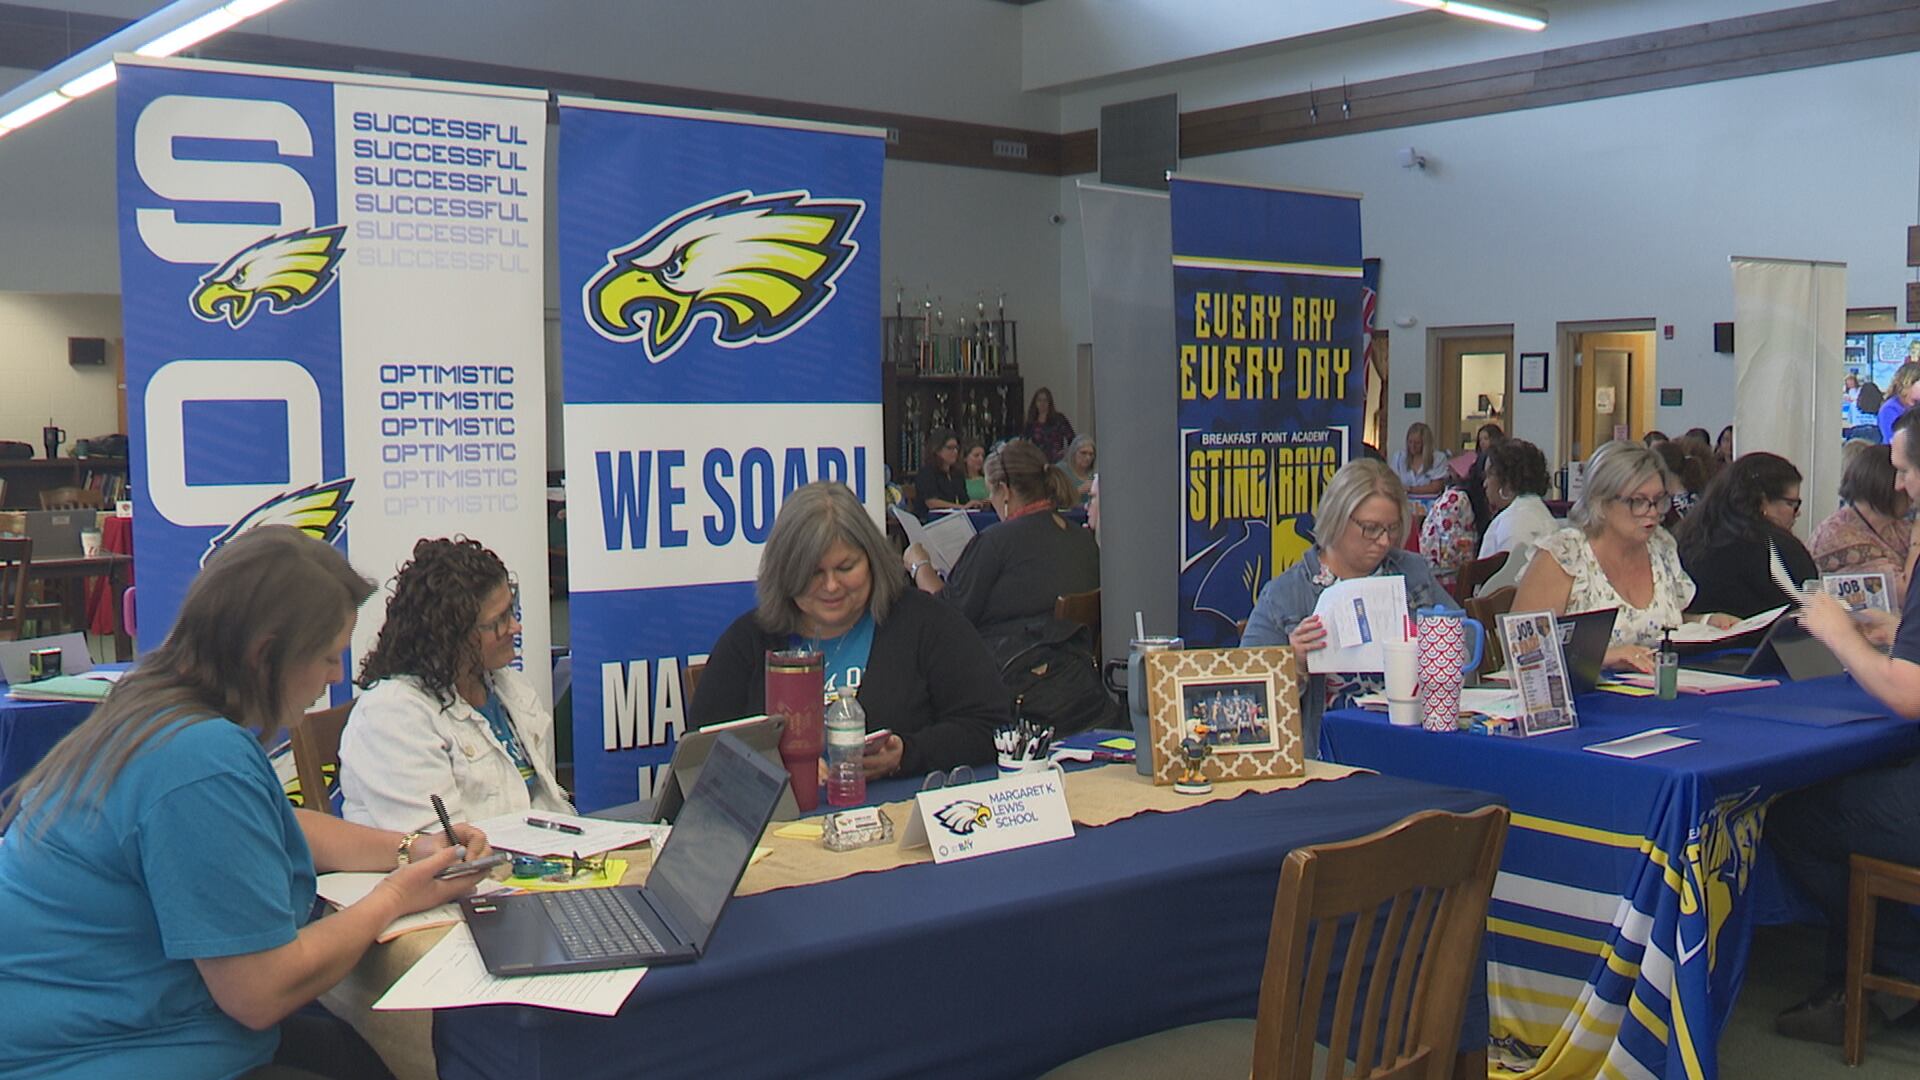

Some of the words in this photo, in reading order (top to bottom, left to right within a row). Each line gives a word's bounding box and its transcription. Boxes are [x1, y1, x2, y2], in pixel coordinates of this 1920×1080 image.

[353, 112, 528, 145] SUCCESSFUL
[353, 139, 528, 171] SUCCESSFUL
[354, 166, 528, 197] SUCCESSFUL
[355, 193, 529, 223] SUCCESSFUL
[356, 220, 529, 248] SUCCESSFUL
[357, 247, 529, 273] SUCCESSFUL
[1195, 292, 1282, 341] EVERY
[1292, 296, 1336, 342] RAY
[380, 364, 514, 384] OPTIMISTIC
[1180, 344, 1284, 400] EVERY
[1297, 347, 1350, 400] DAY
[380, 391, 514, 410] OPTIMISTIC
[381, 417, 515, 437] OPTIMISTIC
[1201, 432, 1258, 446] BREAKFAST
[1261, 431, 1288, 445] POINT
[1291, 431, 1330, 443] ACADEMY
[382, 443, 516, 463] OPTIMISTIC
[383, 468, 518, 489] OPTIMISTIC
[1189, 447, 1267, 530] STING
[384, 493, 519, 516] OPTIMISTIC
[595, 449, 689, 551] WE
[1837, 579, 1860, 597] JOB
[1516, 620, 1534, 641] JOB
[989, 784, 1044, 804] MARGARET
[1045, 782, 1056, 795] K.
[992, 800, 1025, 816] LEWIS
[995, 811, 1039, 828] SCHOOL
